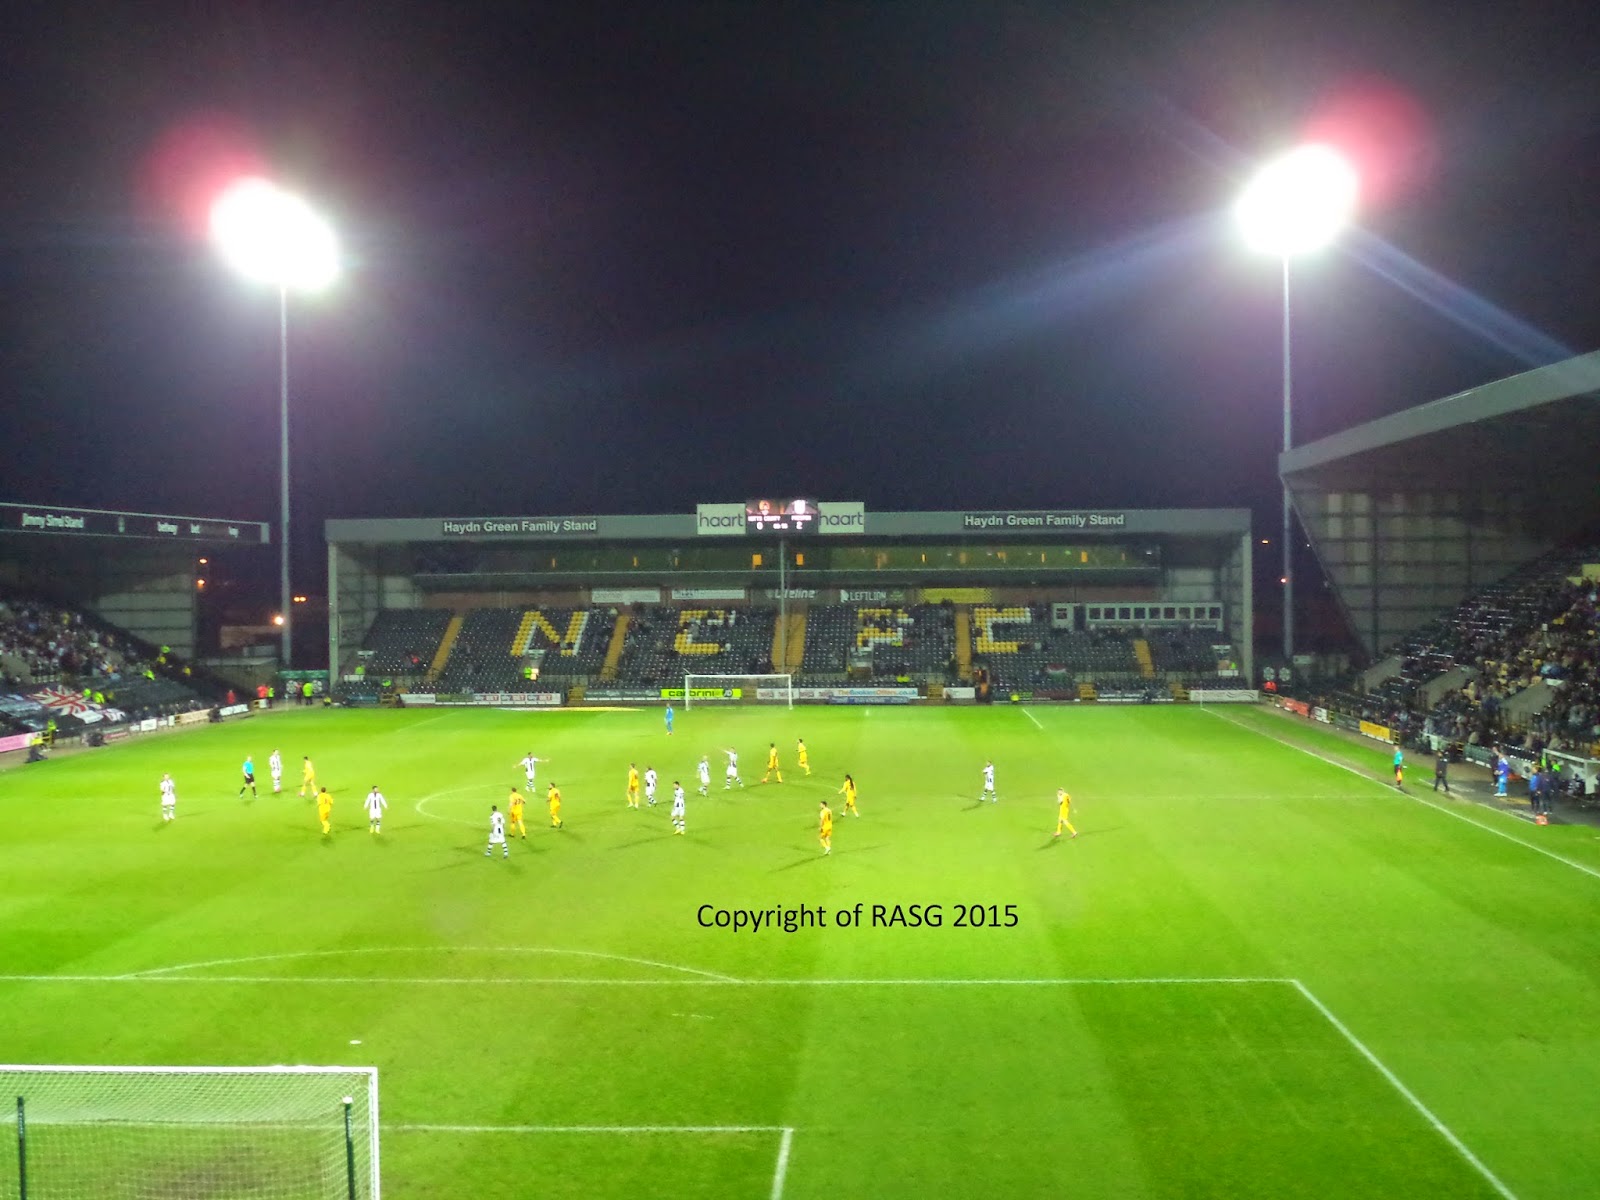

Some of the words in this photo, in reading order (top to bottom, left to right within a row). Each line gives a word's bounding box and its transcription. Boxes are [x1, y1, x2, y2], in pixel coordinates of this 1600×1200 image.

[699, 512, 744, 527] haart
[819, 511, 863, 526] haart
[964, 515, 1003, 528] Haydn
[1006, 515, 1043, 526] Green
[1046, 514, 1086, 527] Family
[1089, 514, 1124, 525] Stand
[444, 521, 480, 534] Haydn
[483, 521, 518, 532] Green
[521, 520, 560, 533] Family
[563, 520, 597, 531] Stand
